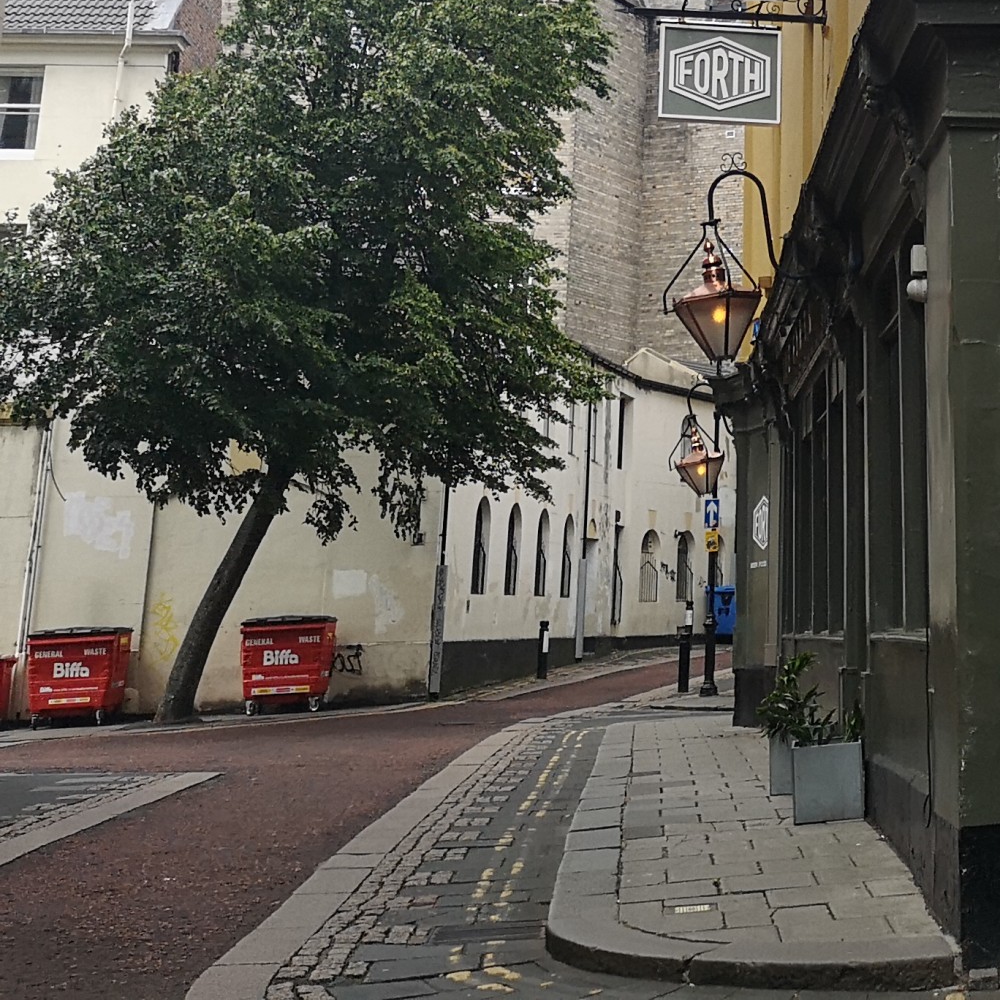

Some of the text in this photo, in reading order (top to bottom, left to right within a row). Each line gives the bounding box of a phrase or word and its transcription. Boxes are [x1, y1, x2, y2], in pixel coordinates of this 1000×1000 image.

[680, 48, 760, 98] FORTH
[298, 635, 320, 643] WASTE
[34, 647, 107, 659] GENERAL WASTE
[263, 649, 299, 666] Biffa
[53, 662, 90, 678] Biffa
